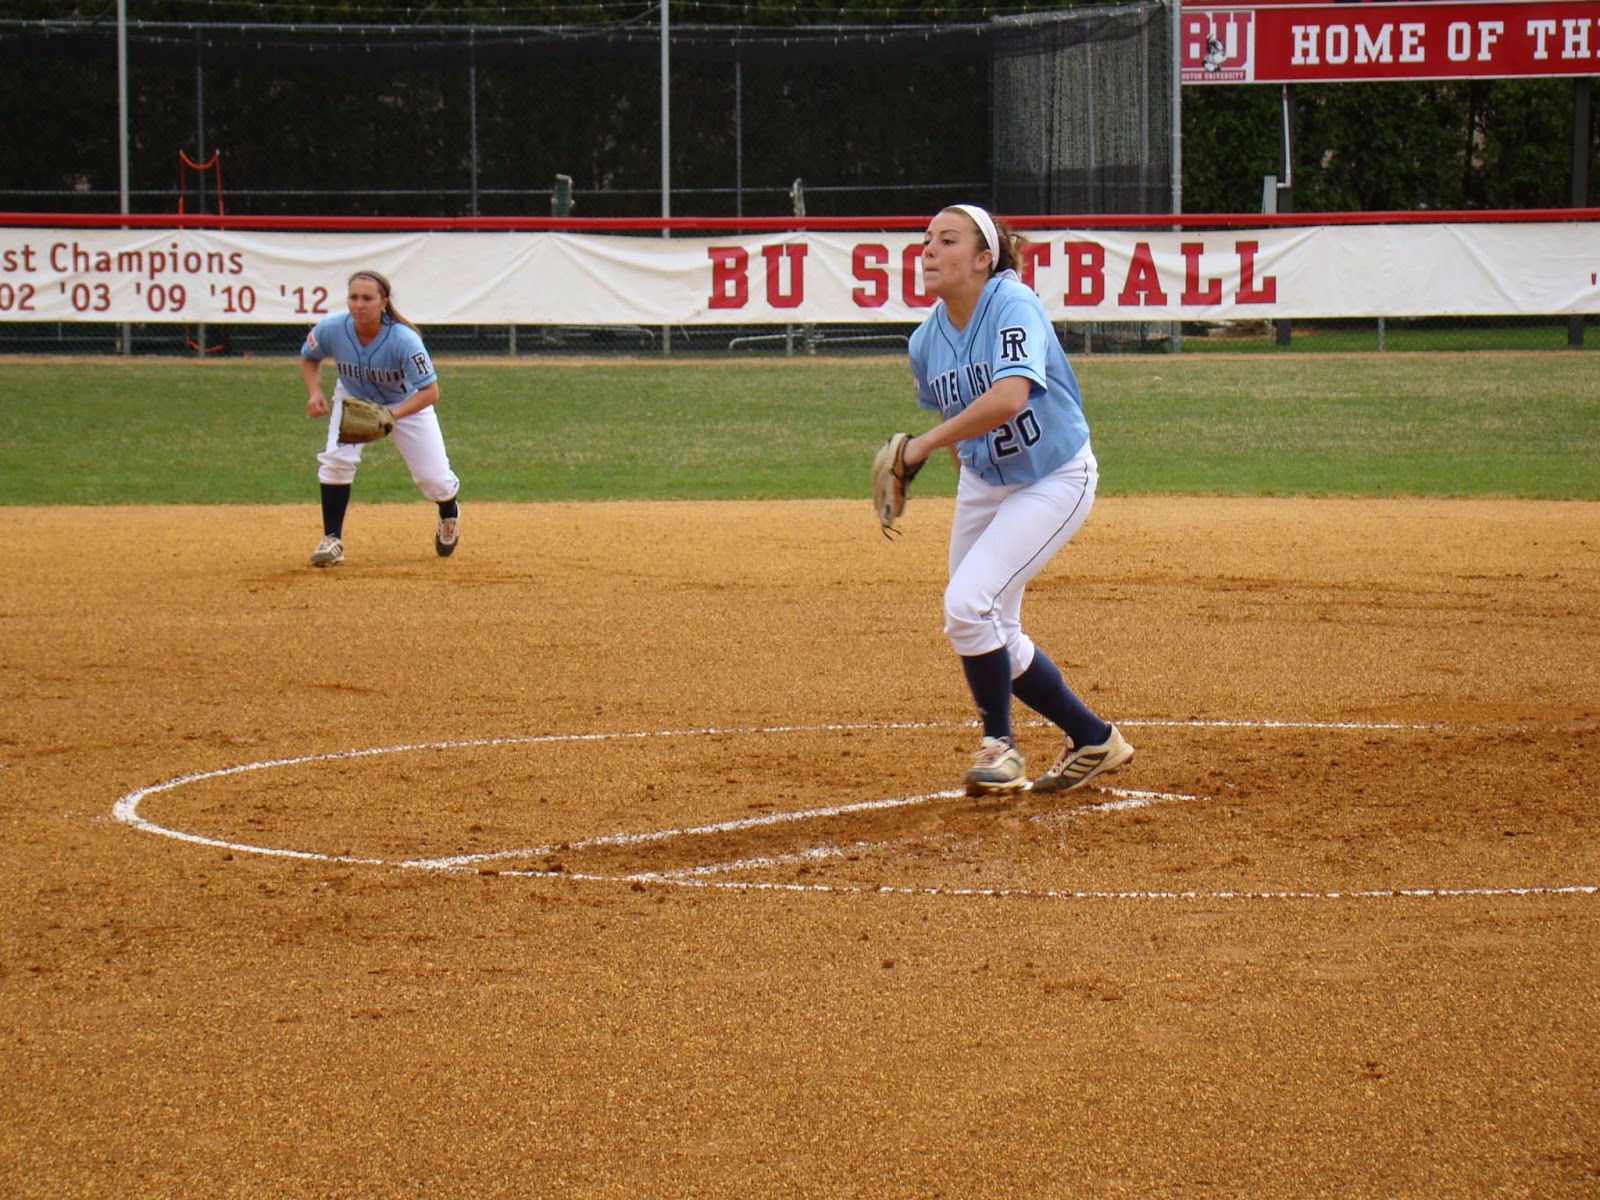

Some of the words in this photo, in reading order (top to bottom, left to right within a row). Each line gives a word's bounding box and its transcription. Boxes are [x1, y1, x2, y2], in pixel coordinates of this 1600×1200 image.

[1291, 23, 1425, 65] HOME
[1447, 21, 1504, 62] OF
[1526, 18, 1600, 60] TH
[3, 244, 37, 272] st
[50, 242, 243, 279] Champions
[708, 243, 808, 309] BU
[852, 241, 1277, 308] SOTBALL
[60, 281, 111, 312] '03
[136, 282, 187, 312] '09
[210, 283, 256, 313] '10
[280, 284, 329, 314] '12
[992, 407, 1042, 460] 20
